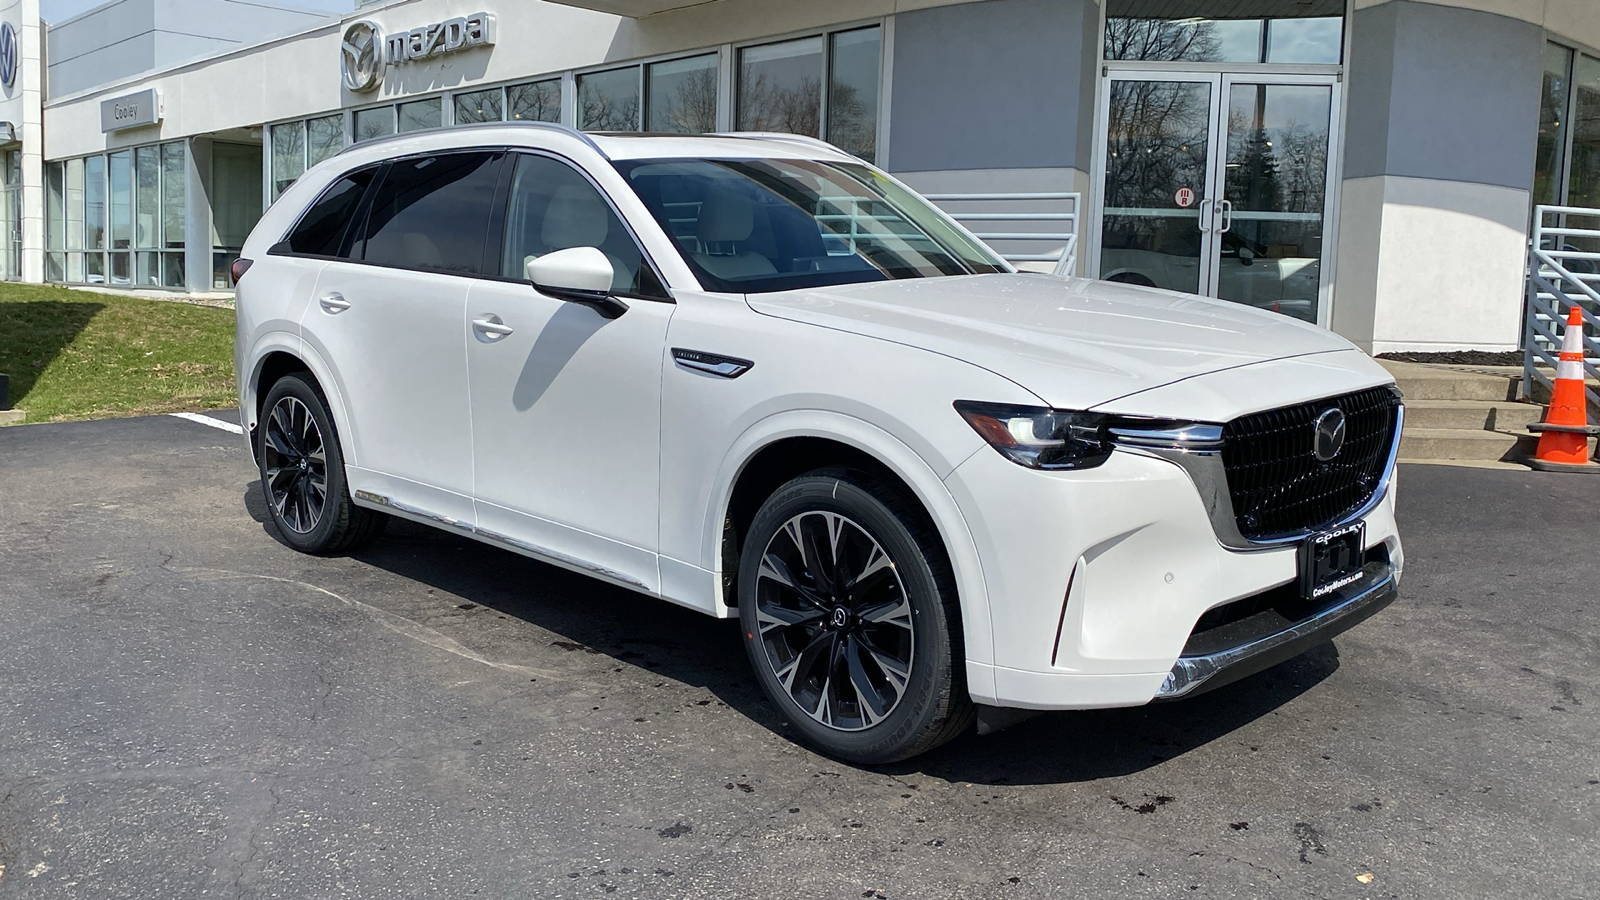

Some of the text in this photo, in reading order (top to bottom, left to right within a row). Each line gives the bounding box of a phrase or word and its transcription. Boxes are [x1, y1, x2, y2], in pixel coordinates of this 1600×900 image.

[114, 101, 138, 121] Cooley
[1181, 197, 1188, 205] R
[1315, 521, 1364, 544] COOLEY
[1312, 571, 1363, 597] CooleyMotors.com
